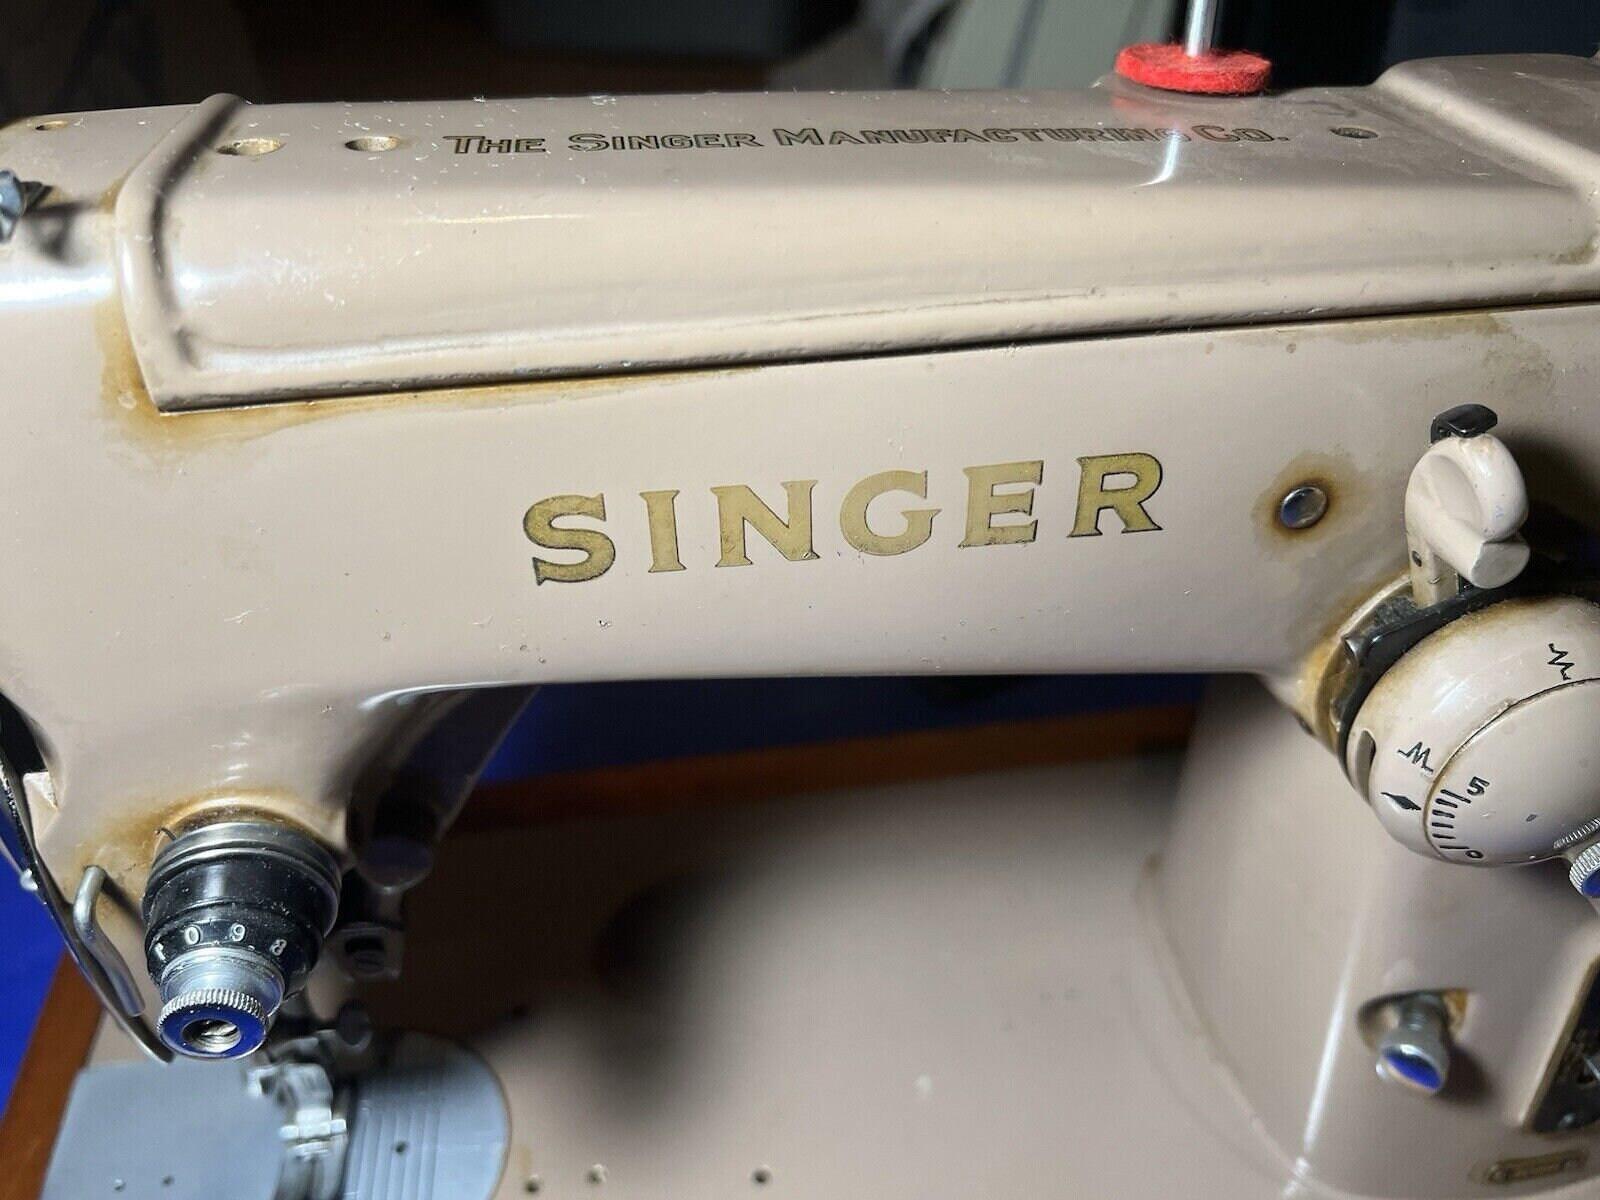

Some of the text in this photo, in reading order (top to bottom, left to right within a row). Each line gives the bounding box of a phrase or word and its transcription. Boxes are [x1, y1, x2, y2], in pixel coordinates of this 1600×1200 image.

[523, 452, 1164, 586] SINGER
[1467, 776, 1490, 796] 5
[184, 925, 201, 945] 0
[270, 938, 287, 956] 8
